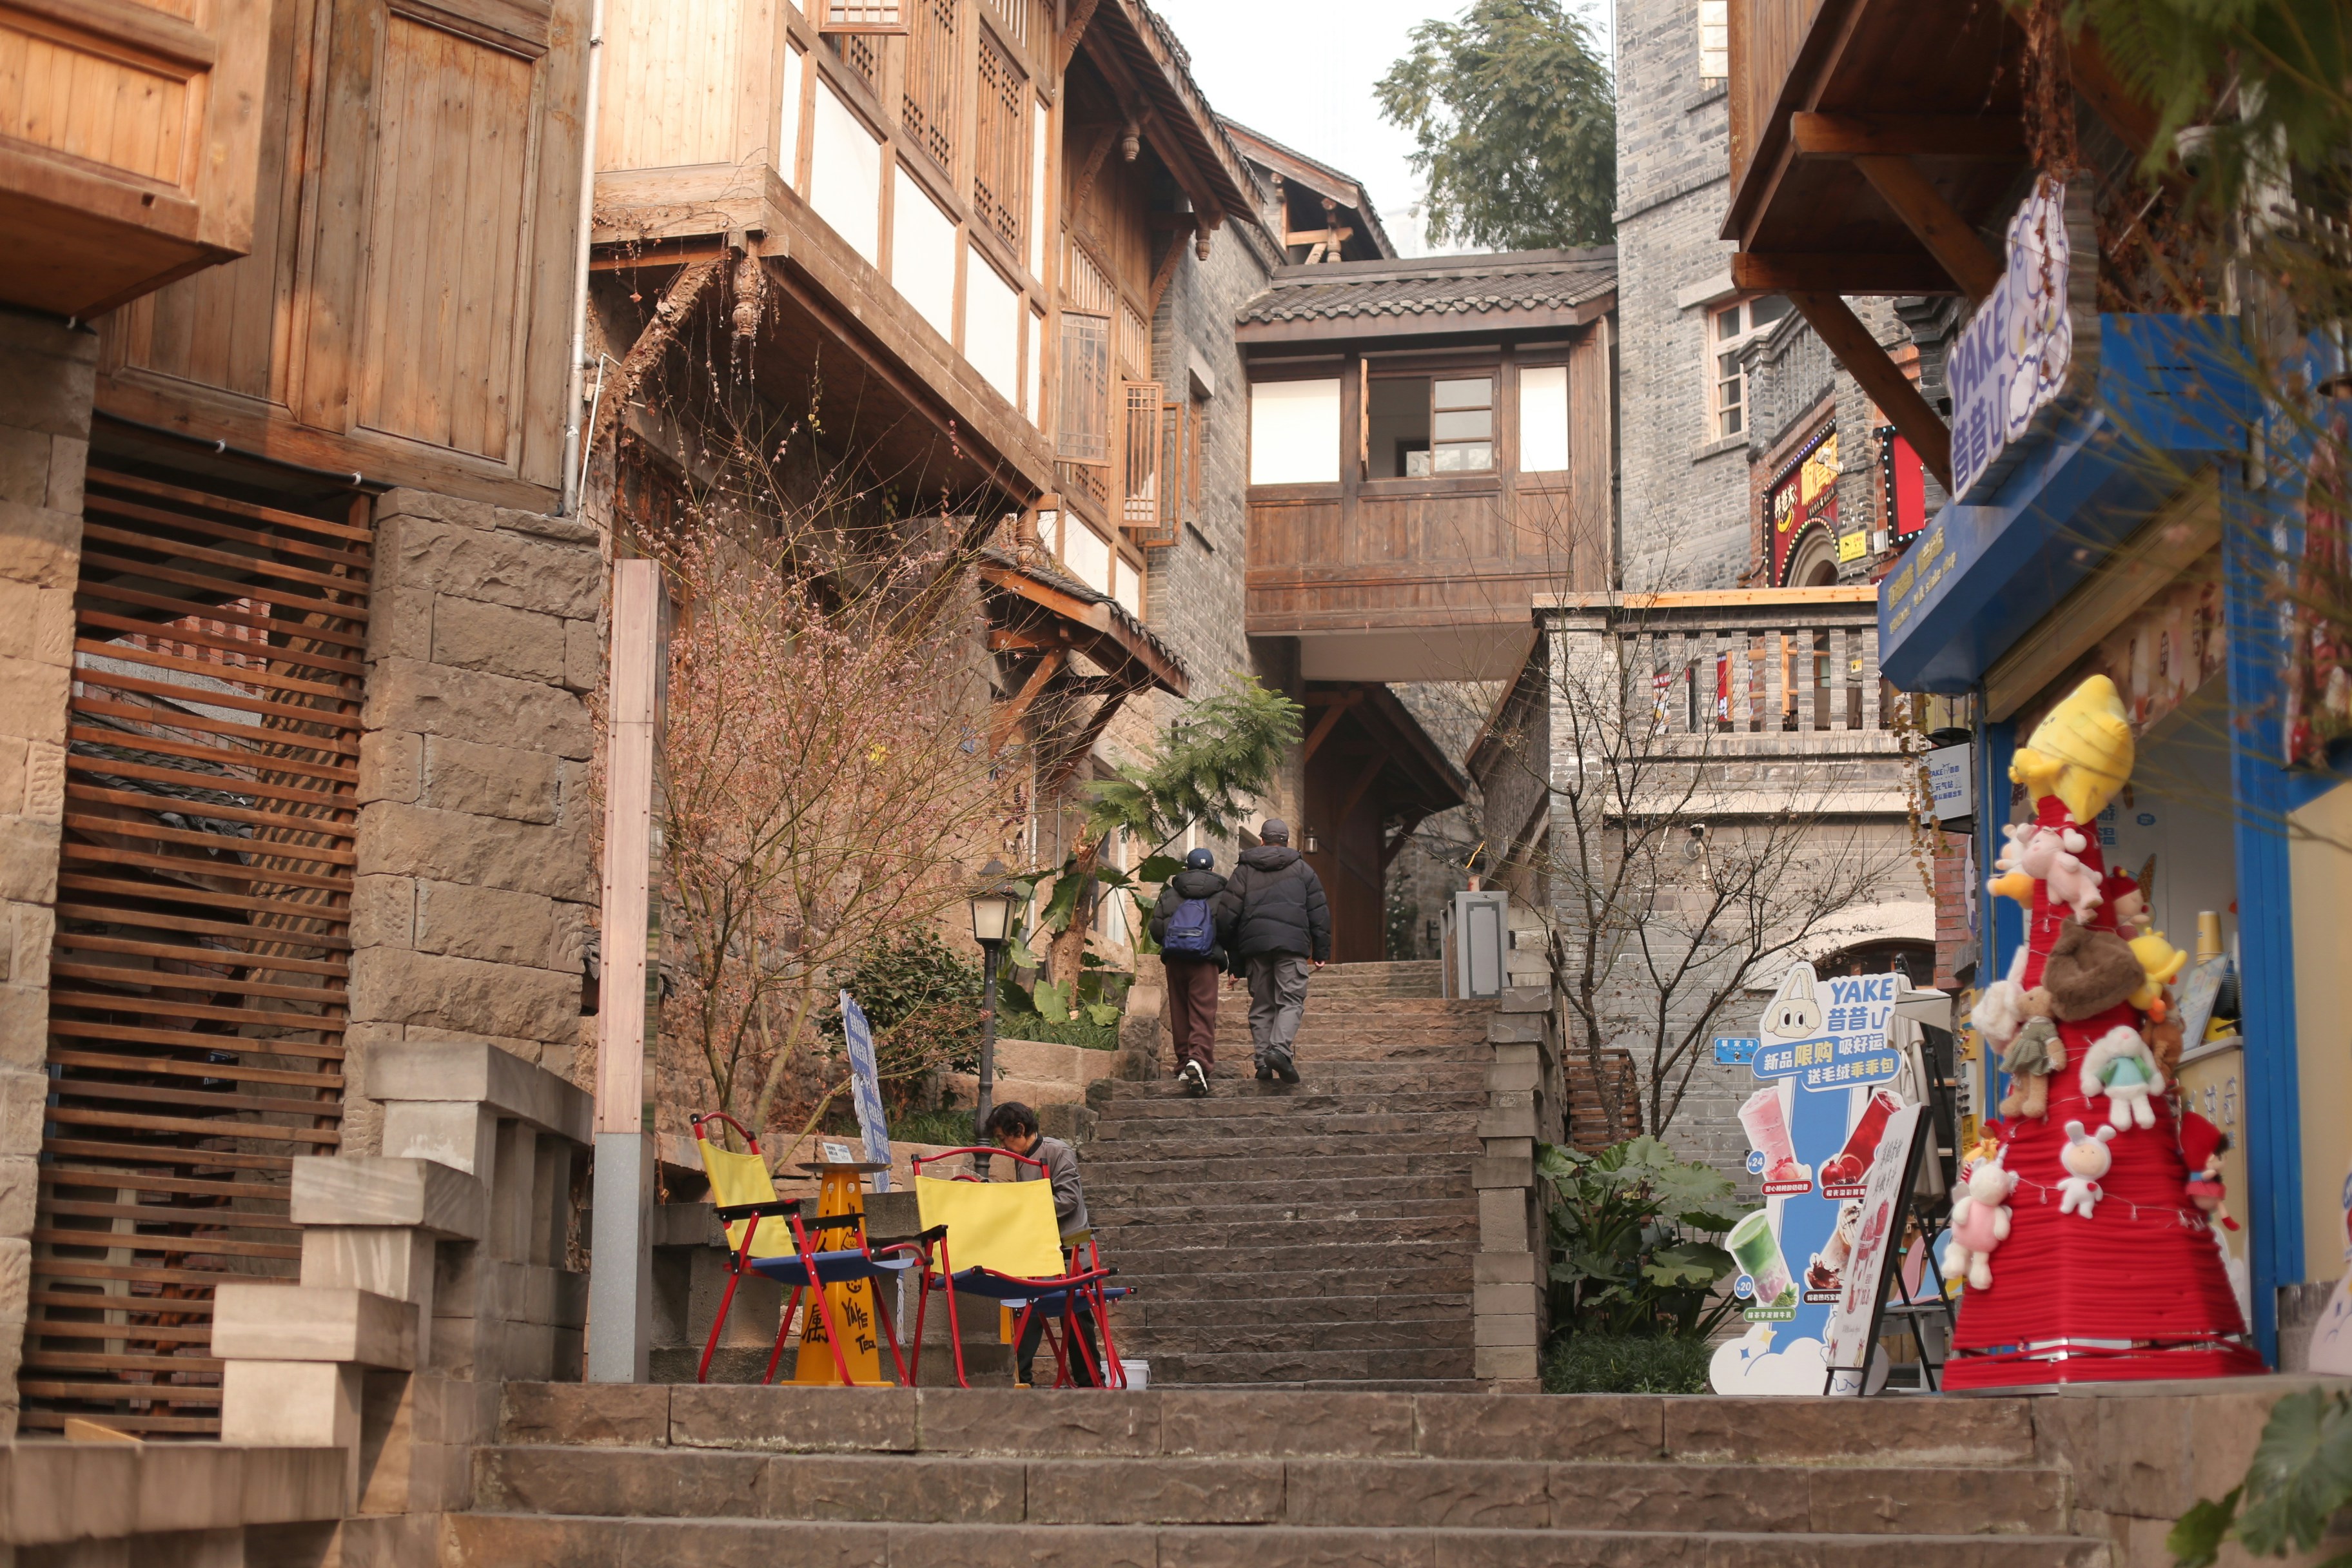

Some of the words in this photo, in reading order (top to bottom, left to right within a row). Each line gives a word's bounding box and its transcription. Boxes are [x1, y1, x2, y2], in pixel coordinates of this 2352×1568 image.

[1949, 288, 2006, 418] YAKE
[1830, 978, 1894, 1005] YAKE
[1764, 1041, 1834, 1071] 新品限购
[1838, 1035, 1883, 1055] 吸好运
[1807, 1057, 1894, 1085] 送毛绒乖乖包
